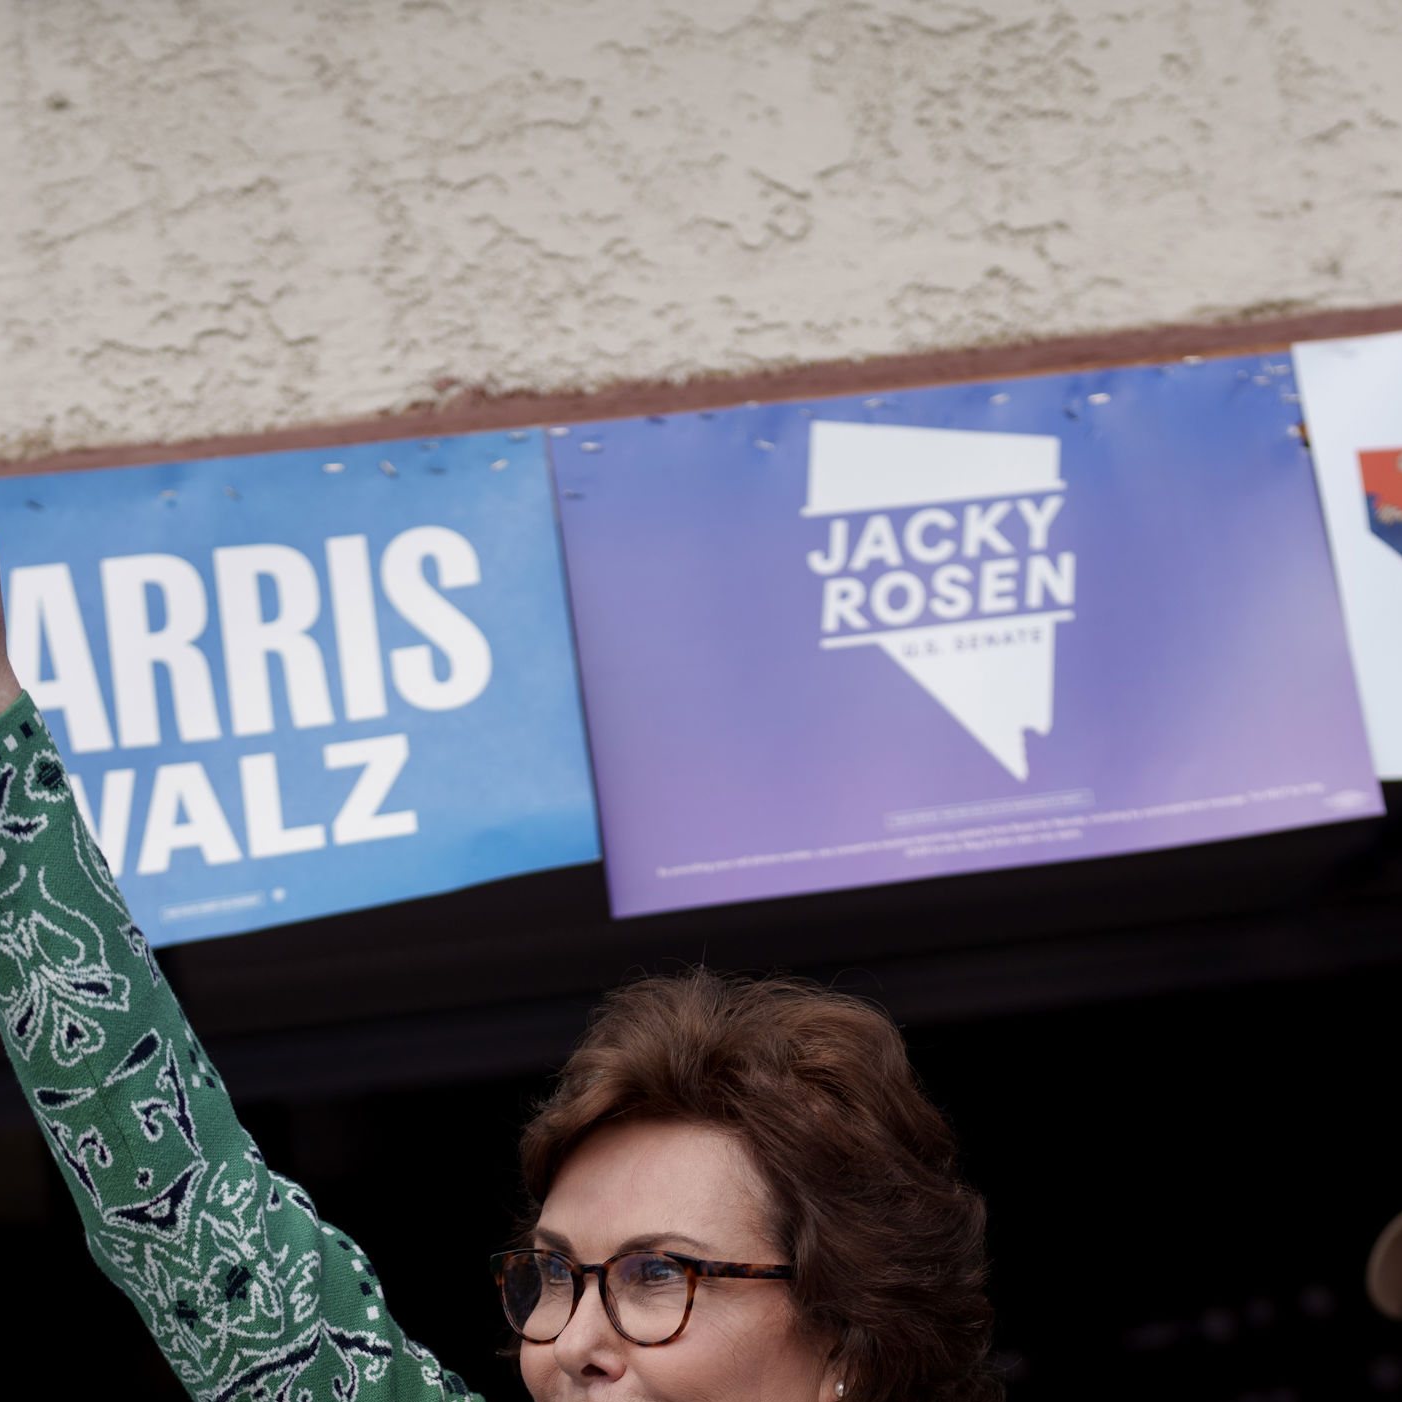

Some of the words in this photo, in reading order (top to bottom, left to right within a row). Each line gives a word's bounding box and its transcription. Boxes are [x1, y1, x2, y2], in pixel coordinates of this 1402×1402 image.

[806, 494, 1065, 576] JACKY
[820, 550, 1077, 634] ROSEN
[901, 637, 944, 657] U.S.
[954, 626, 1043, 651] SENATE
